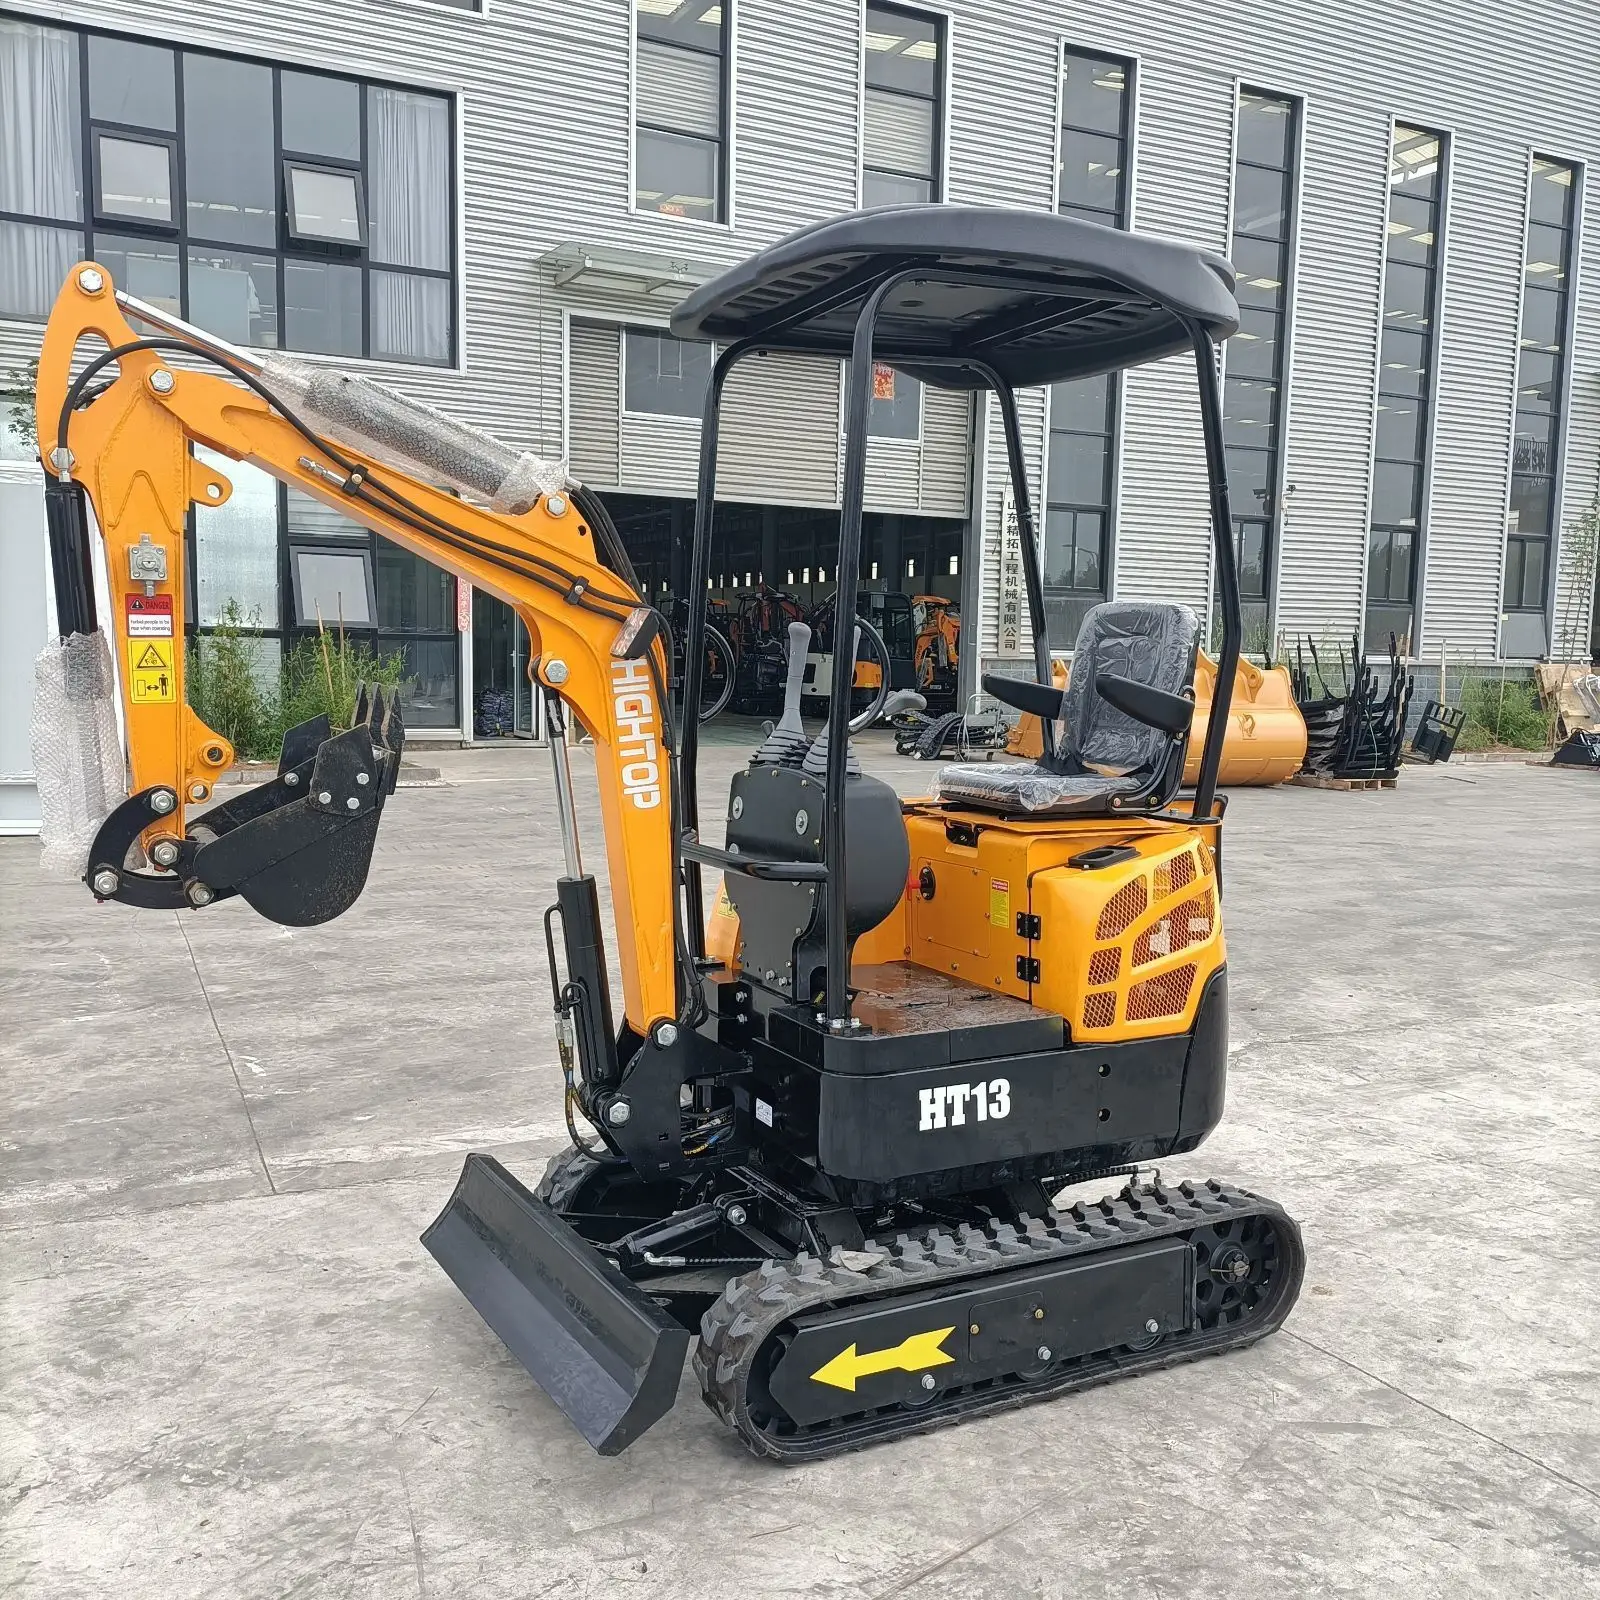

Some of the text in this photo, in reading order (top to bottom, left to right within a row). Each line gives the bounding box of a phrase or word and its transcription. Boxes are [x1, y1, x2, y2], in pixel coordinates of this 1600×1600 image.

[145, 601, 169, 609] DANGER
[1003, 500, 1019, 650] 山东精拓工程机械有限公司
[611, 659, 661, 809] HIGHTOP
[919, 1078, 1011, 1132] HT13
